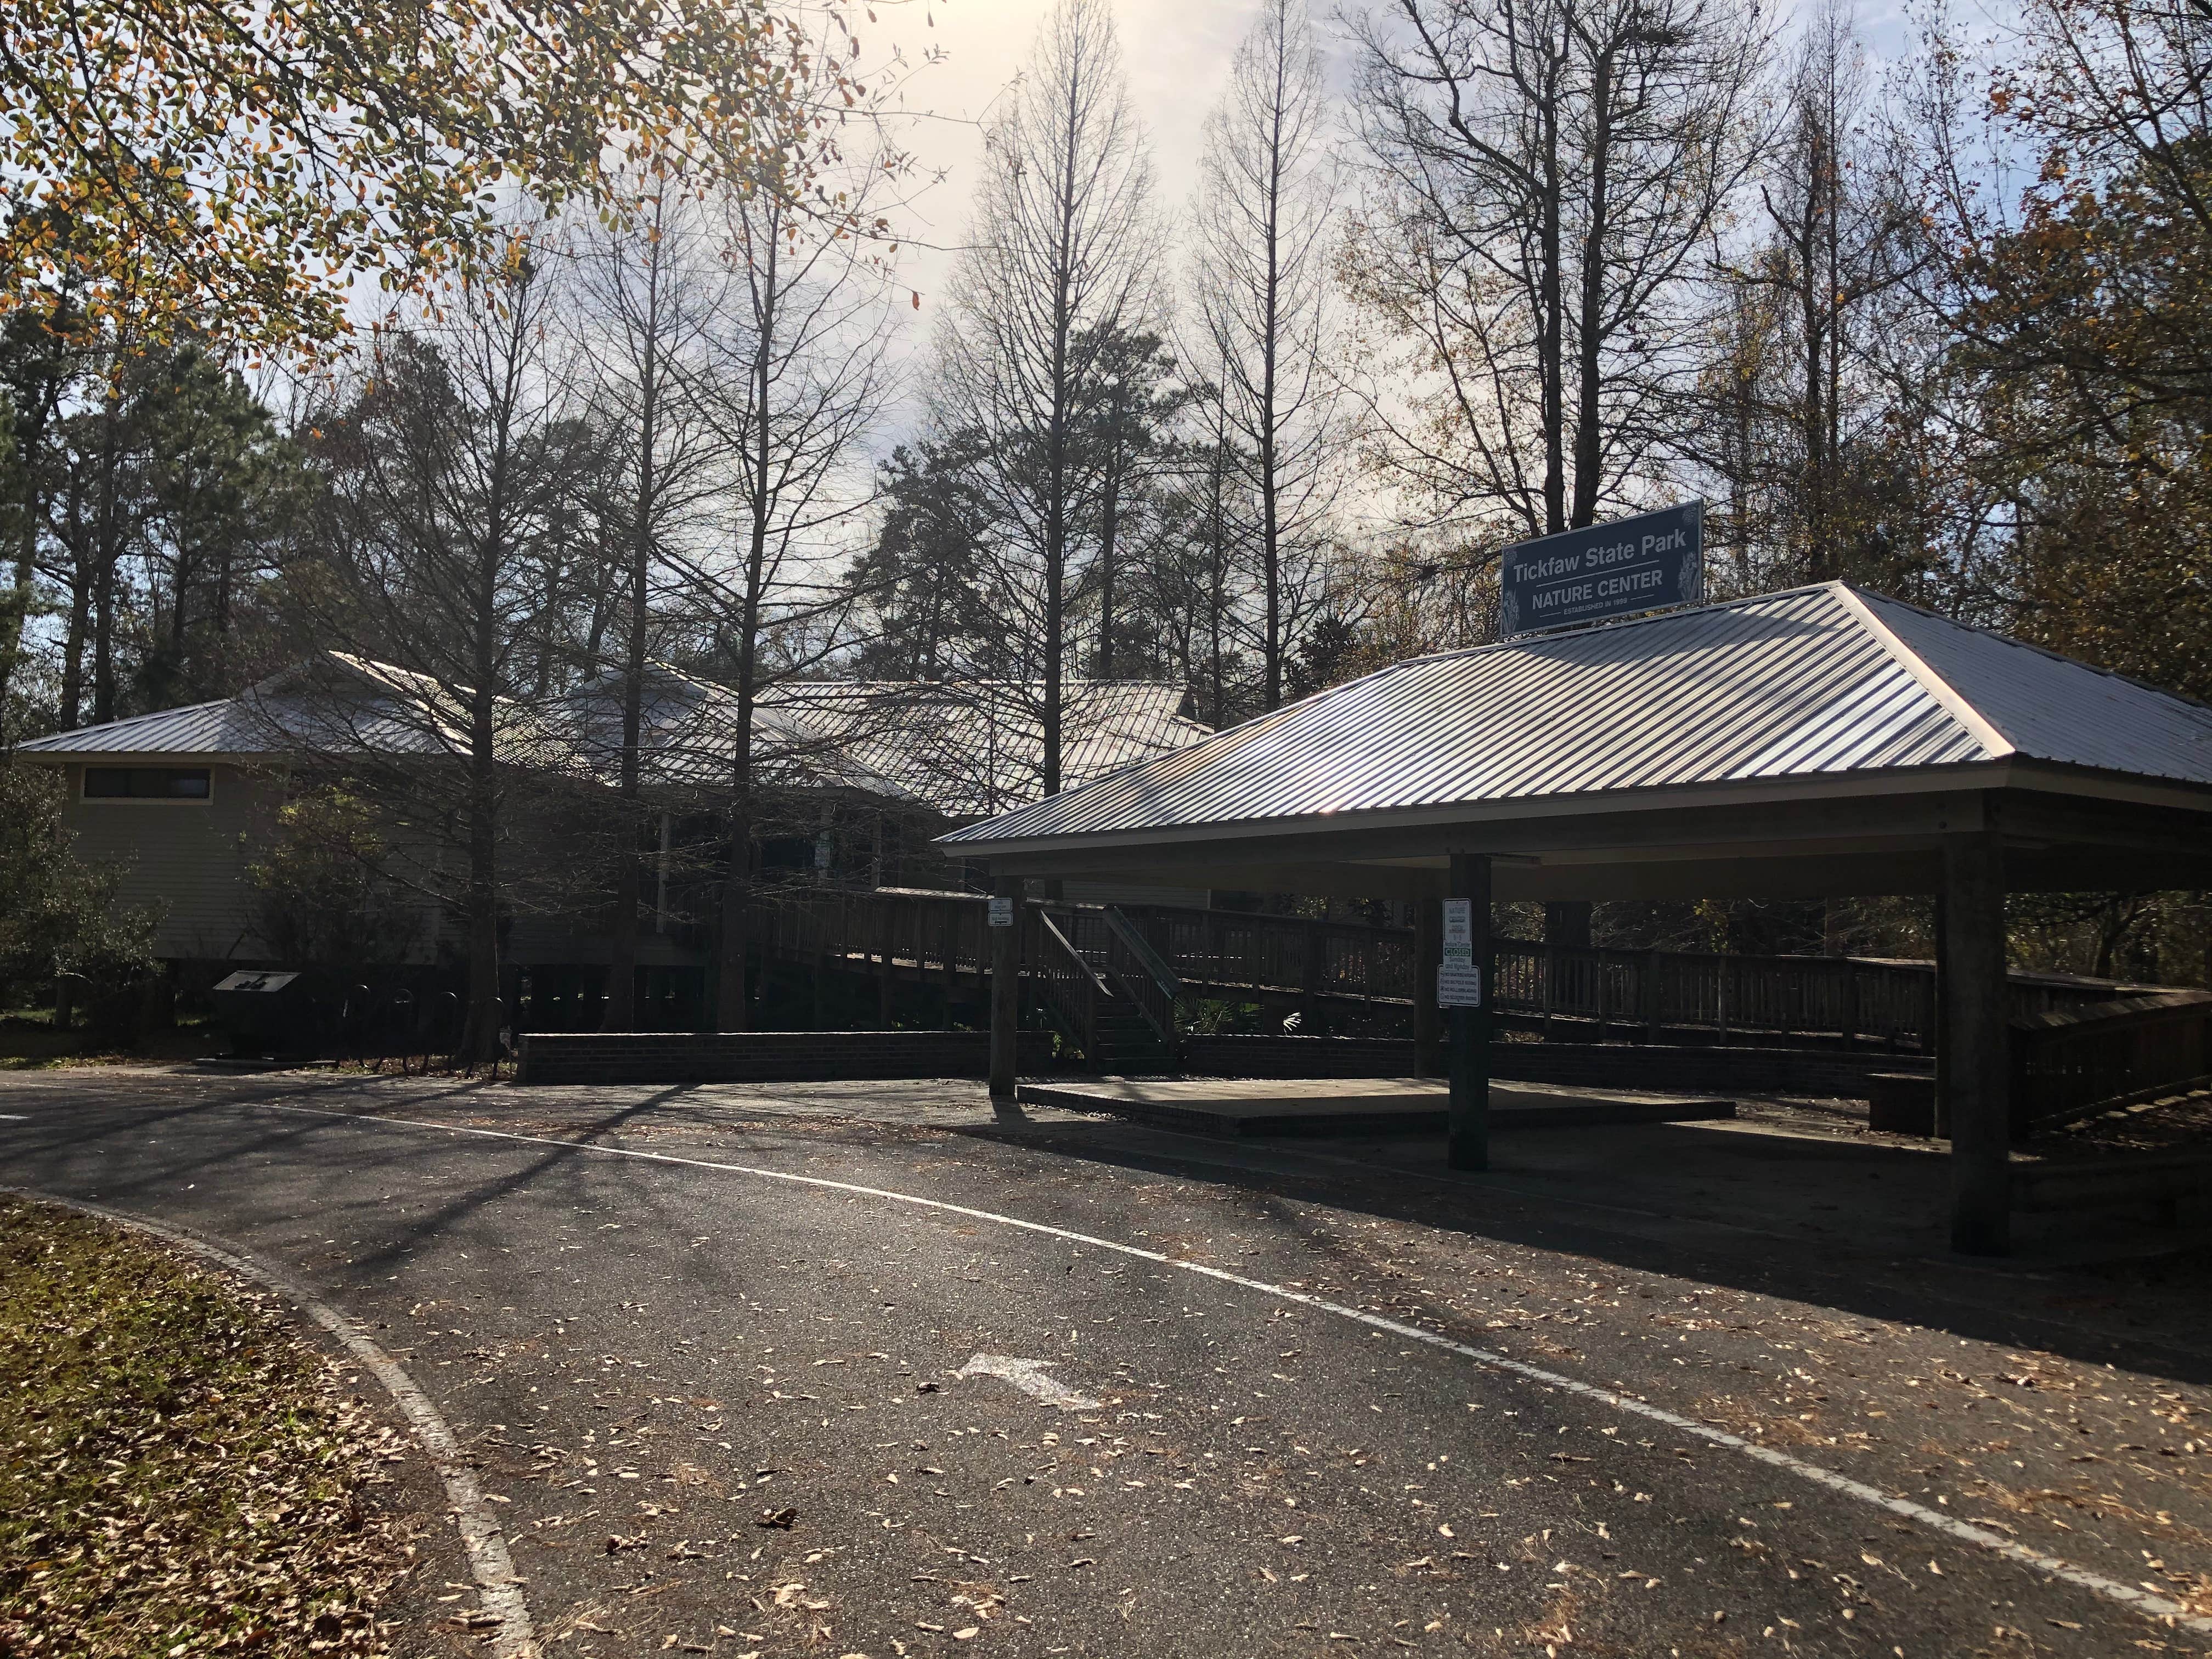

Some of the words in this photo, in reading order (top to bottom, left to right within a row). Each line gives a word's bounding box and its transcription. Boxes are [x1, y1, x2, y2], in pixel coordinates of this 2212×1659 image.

[1513, 555, 1580, 583] Tickfaw
[1585, 543, 1634, 567] State
[1641, 528, 1686, 555] Park
[1532, 584, 1592, 610] NATURE
[1598, 569, 1662, 596] CENTER
[1564, 602, 1603, 615] ESTABLISHED
[1613, 597, 1628, 606] 1999
